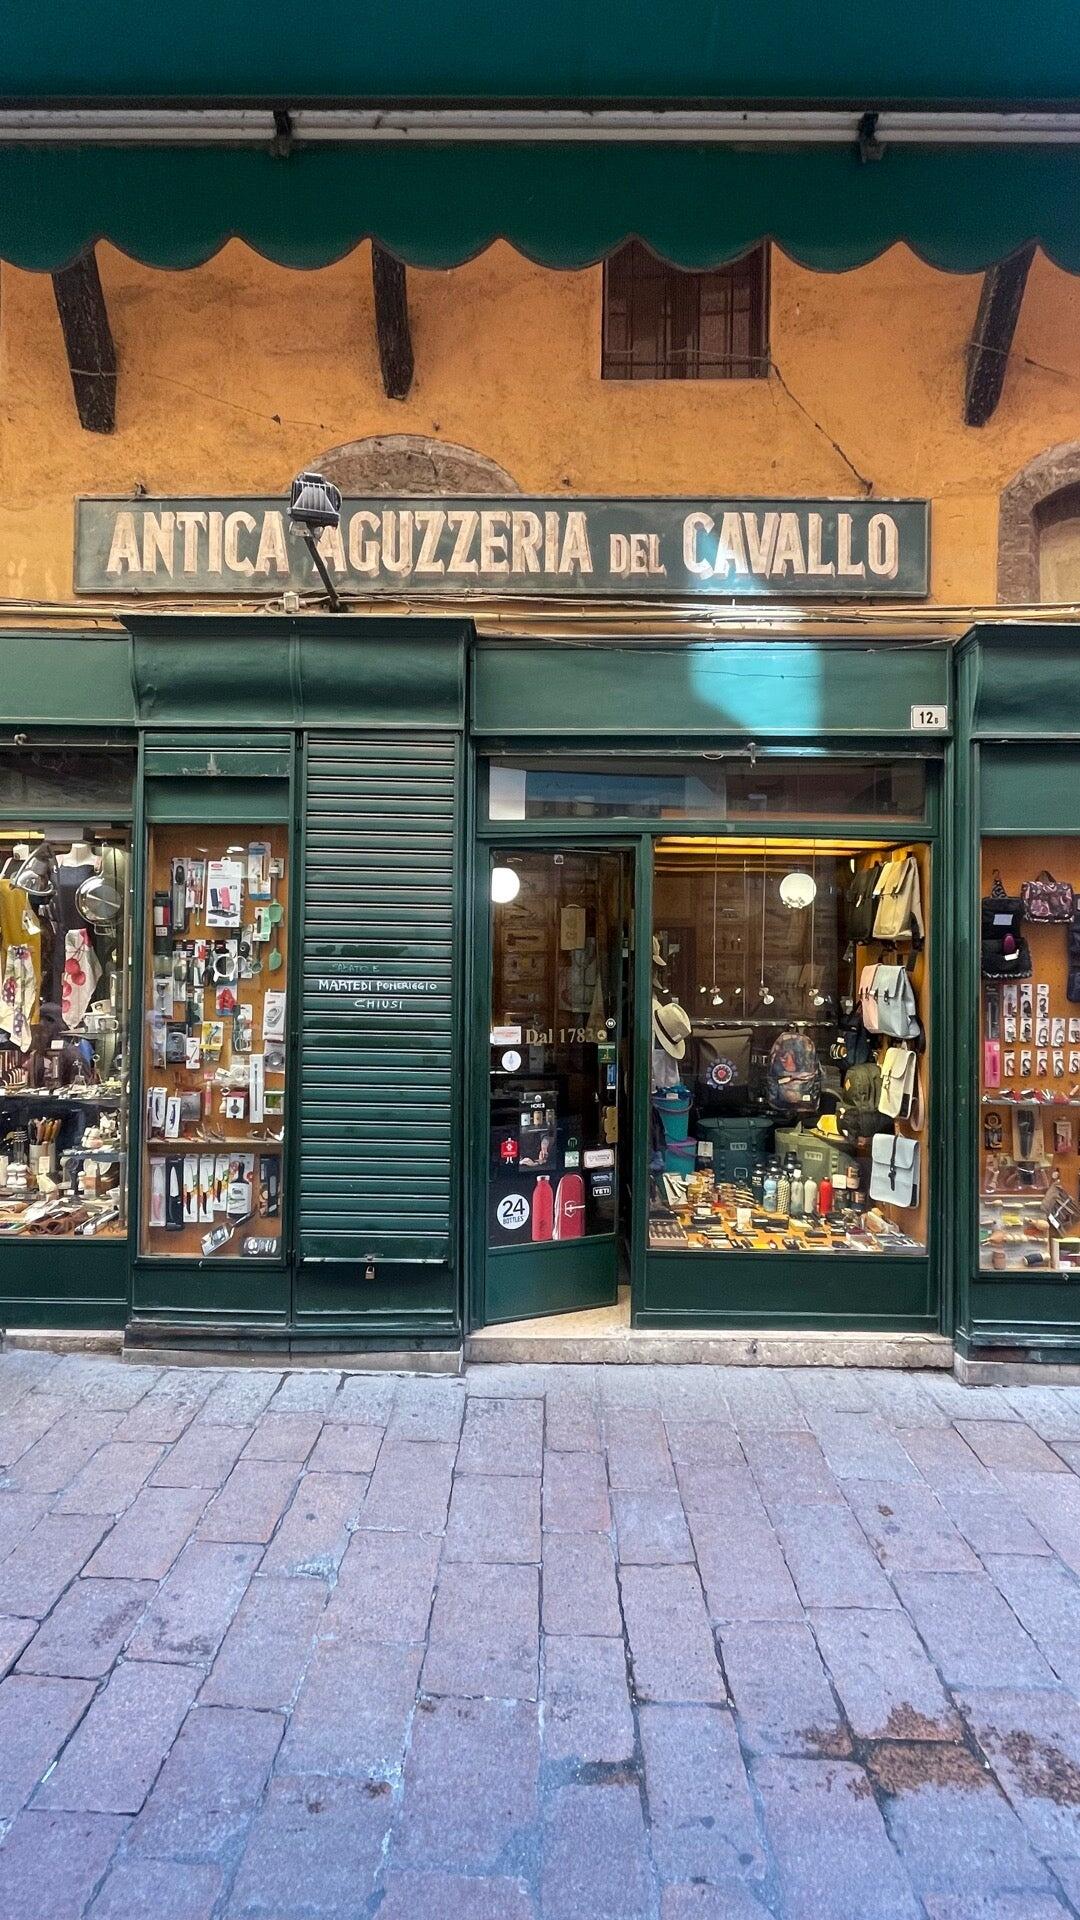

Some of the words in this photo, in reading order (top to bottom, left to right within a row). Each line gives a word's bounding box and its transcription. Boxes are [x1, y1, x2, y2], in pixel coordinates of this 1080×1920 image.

[106, 510, 290, 576] ANTICA
[312, 510, 594, 577] AGUZZERIA
[609, 533, 667, 578] DEL
[682, 511, 899, 579] CAVALLO
[353, 999, 403, 1010] CHIUSI
[525, 1028, 553, 1044] Dal
[559, 1027, 595, 1044] 1783
[502, 1198, 525, 1218] 24
[502, 1216, 524, 1225] BOTTLES
